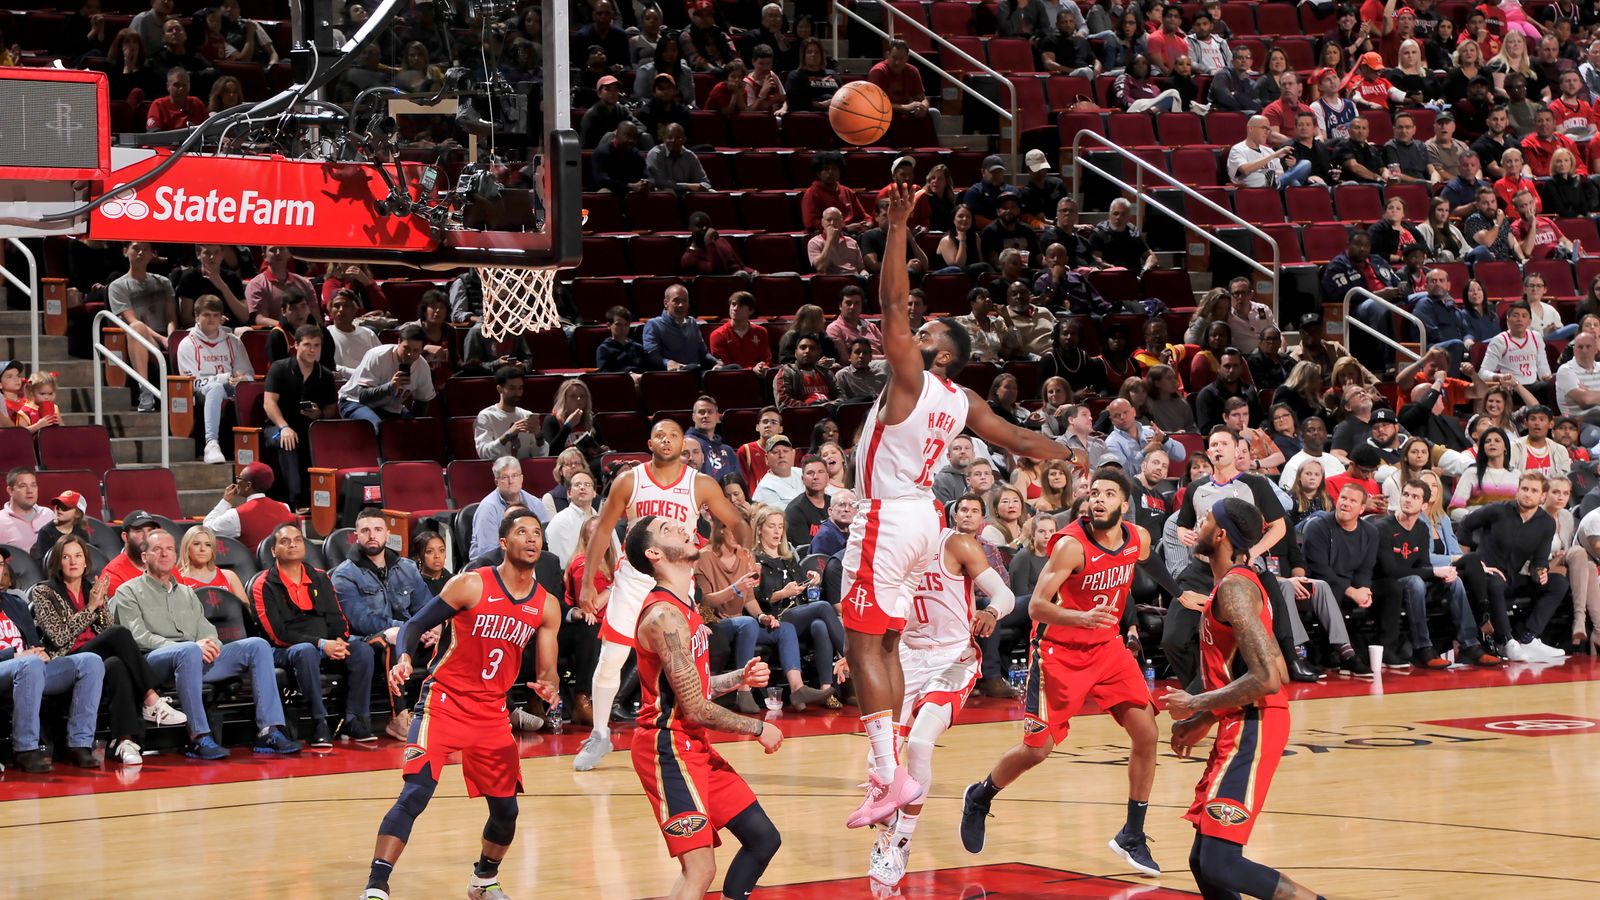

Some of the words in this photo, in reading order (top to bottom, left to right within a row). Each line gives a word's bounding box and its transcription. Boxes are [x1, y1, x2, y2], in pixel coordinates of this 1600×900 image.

[636, 499, 689, 523] ROCKETS
[1081, 563, 1135, 591] PELICAN
[913, 595, 929, 624] 0
[481, 648, 504, 680] 3
